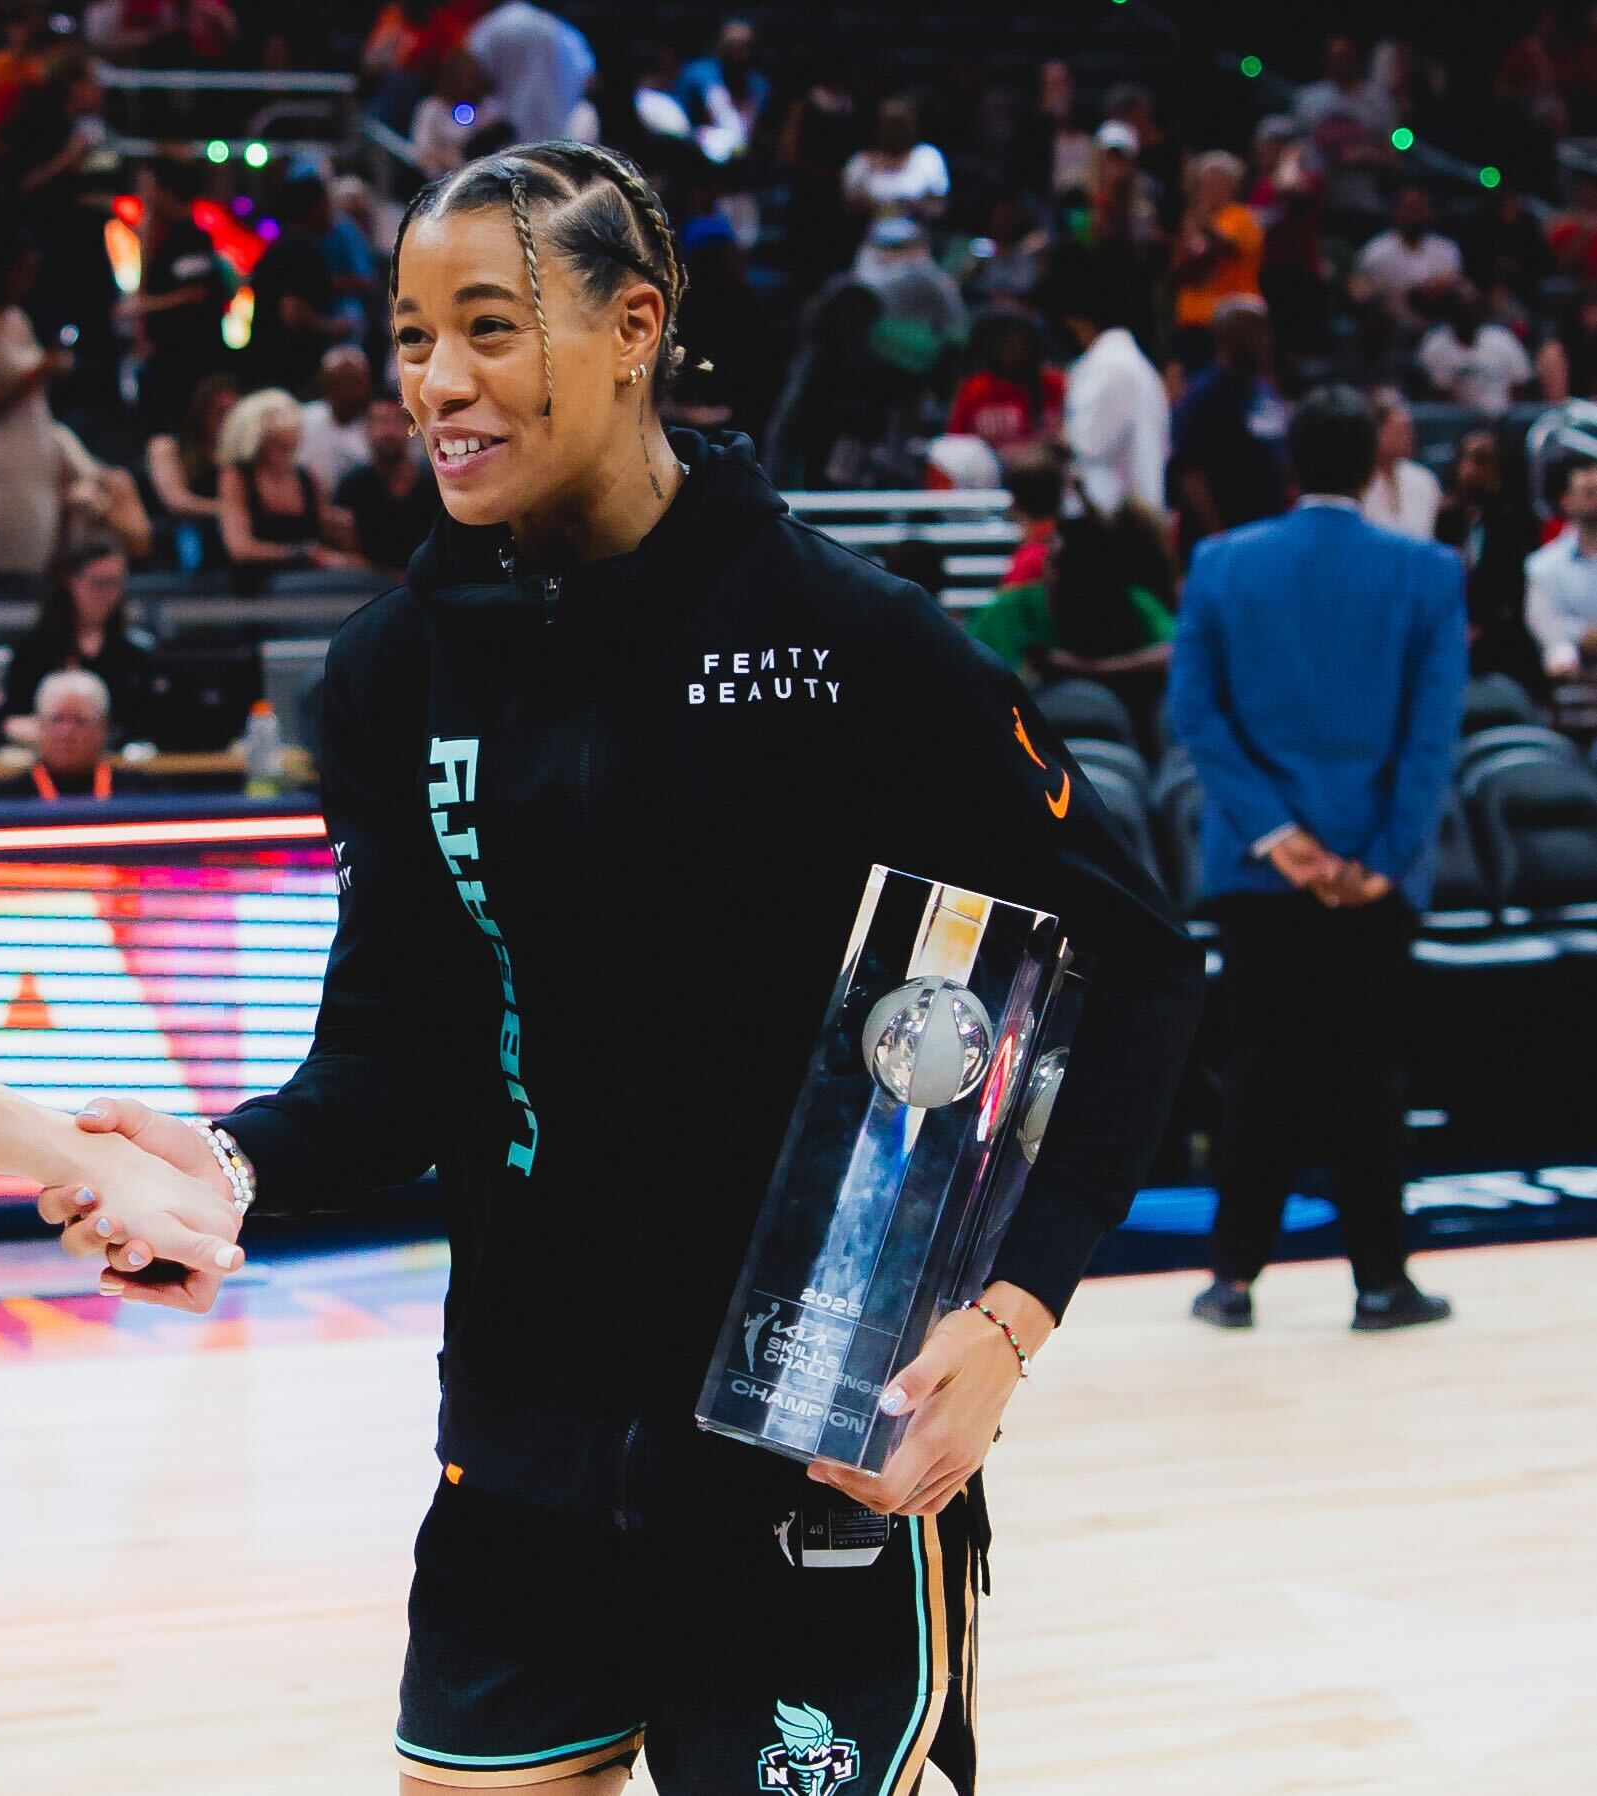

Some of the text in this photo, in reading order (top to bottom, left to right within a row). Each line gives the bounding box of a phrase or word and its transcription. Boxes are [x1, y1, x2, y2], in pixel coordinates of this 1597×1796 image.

[688, 677, 840, 704] BEAUTY
[799, 1287, 864, 1320] 2025
[767, 1336, 841, 1369] SKILLS
